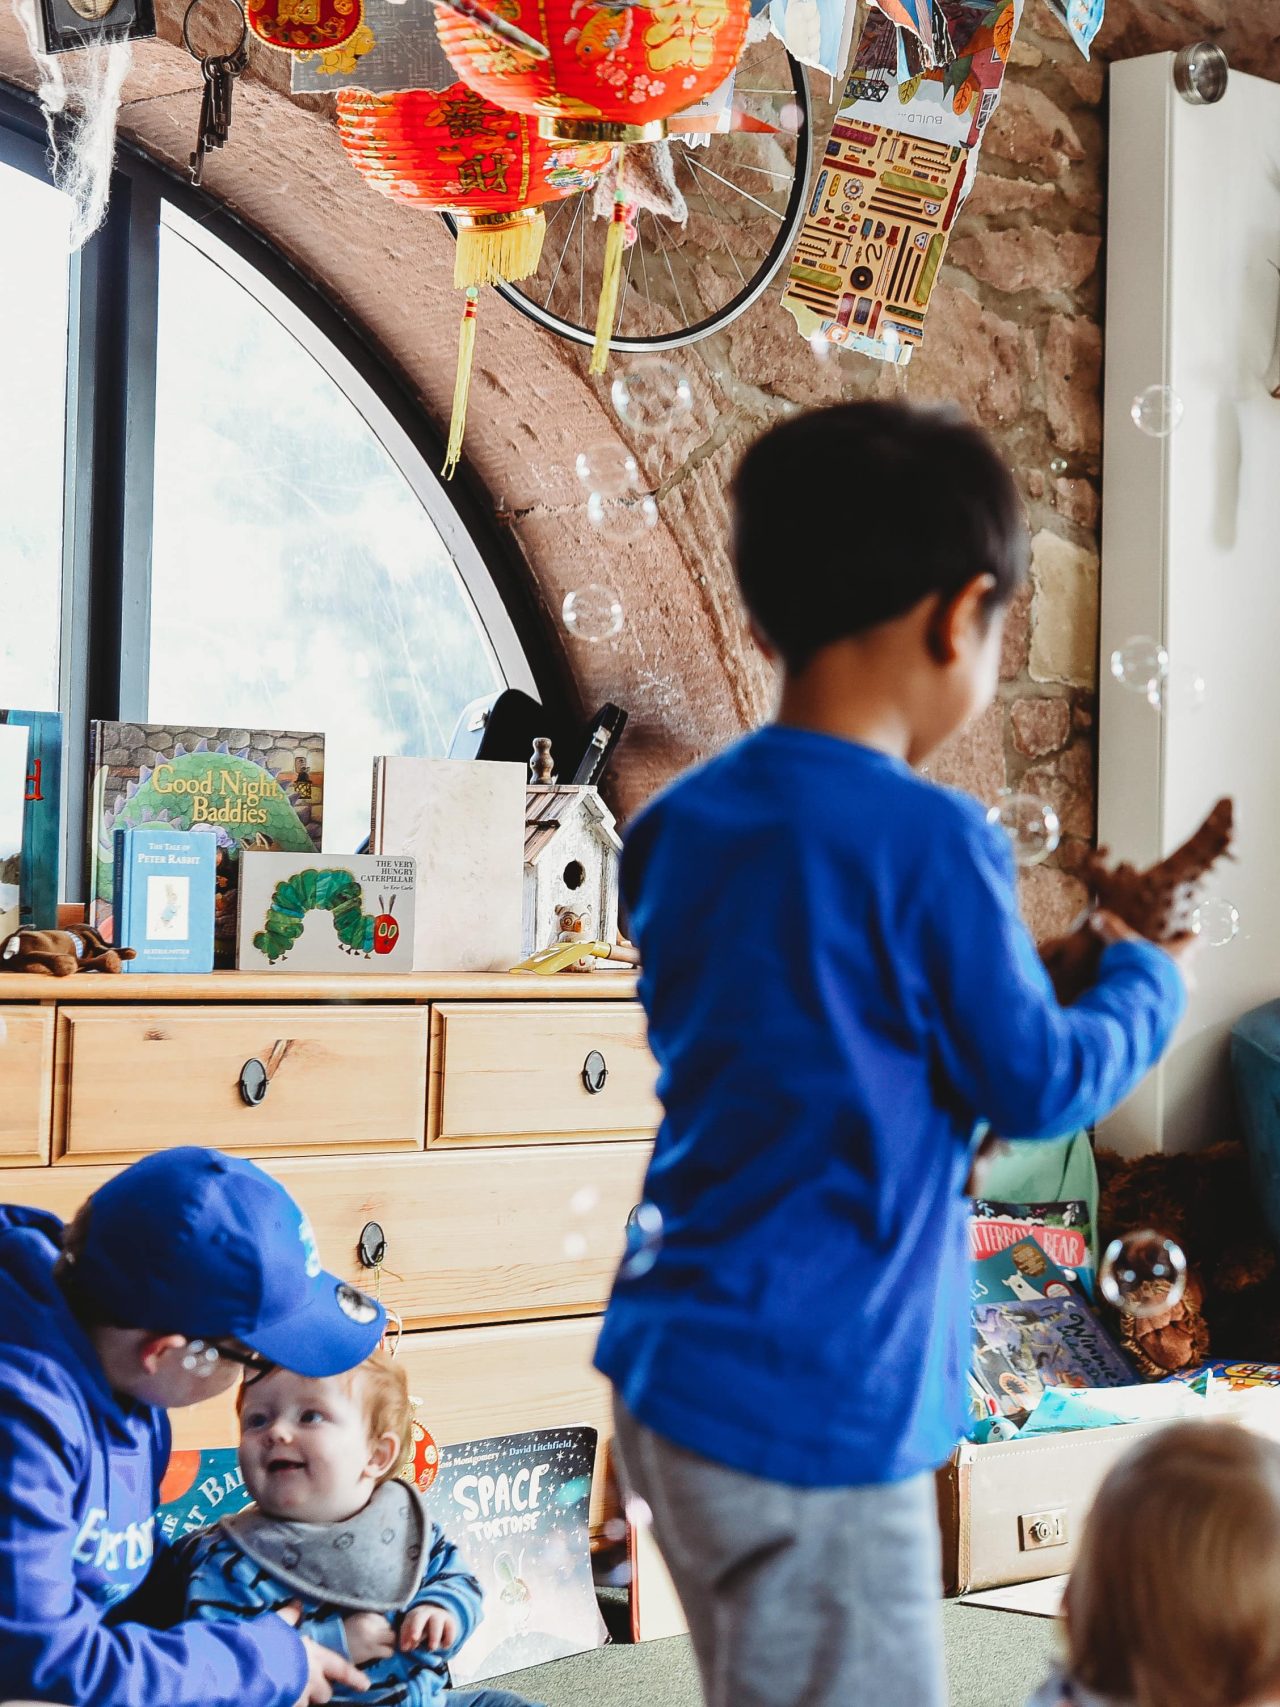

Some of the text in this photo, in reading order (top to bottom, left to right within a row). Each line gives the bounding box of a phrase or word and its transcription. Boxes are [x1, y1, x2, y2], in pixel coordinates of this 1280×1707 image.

[152, 764, 283, 807] Good Night,
[192, 796, 267, 823] Baddies
[1043, 1231, 1079, 1265] BEAR
[439, 1440, 572, 1469] oss Montgomery David Litchfield
[453, 1464, 550, 1521] SPACE
[161, 1513, 179, 1540] HE
[466, 1511, 541, 1541] TORTOISE
